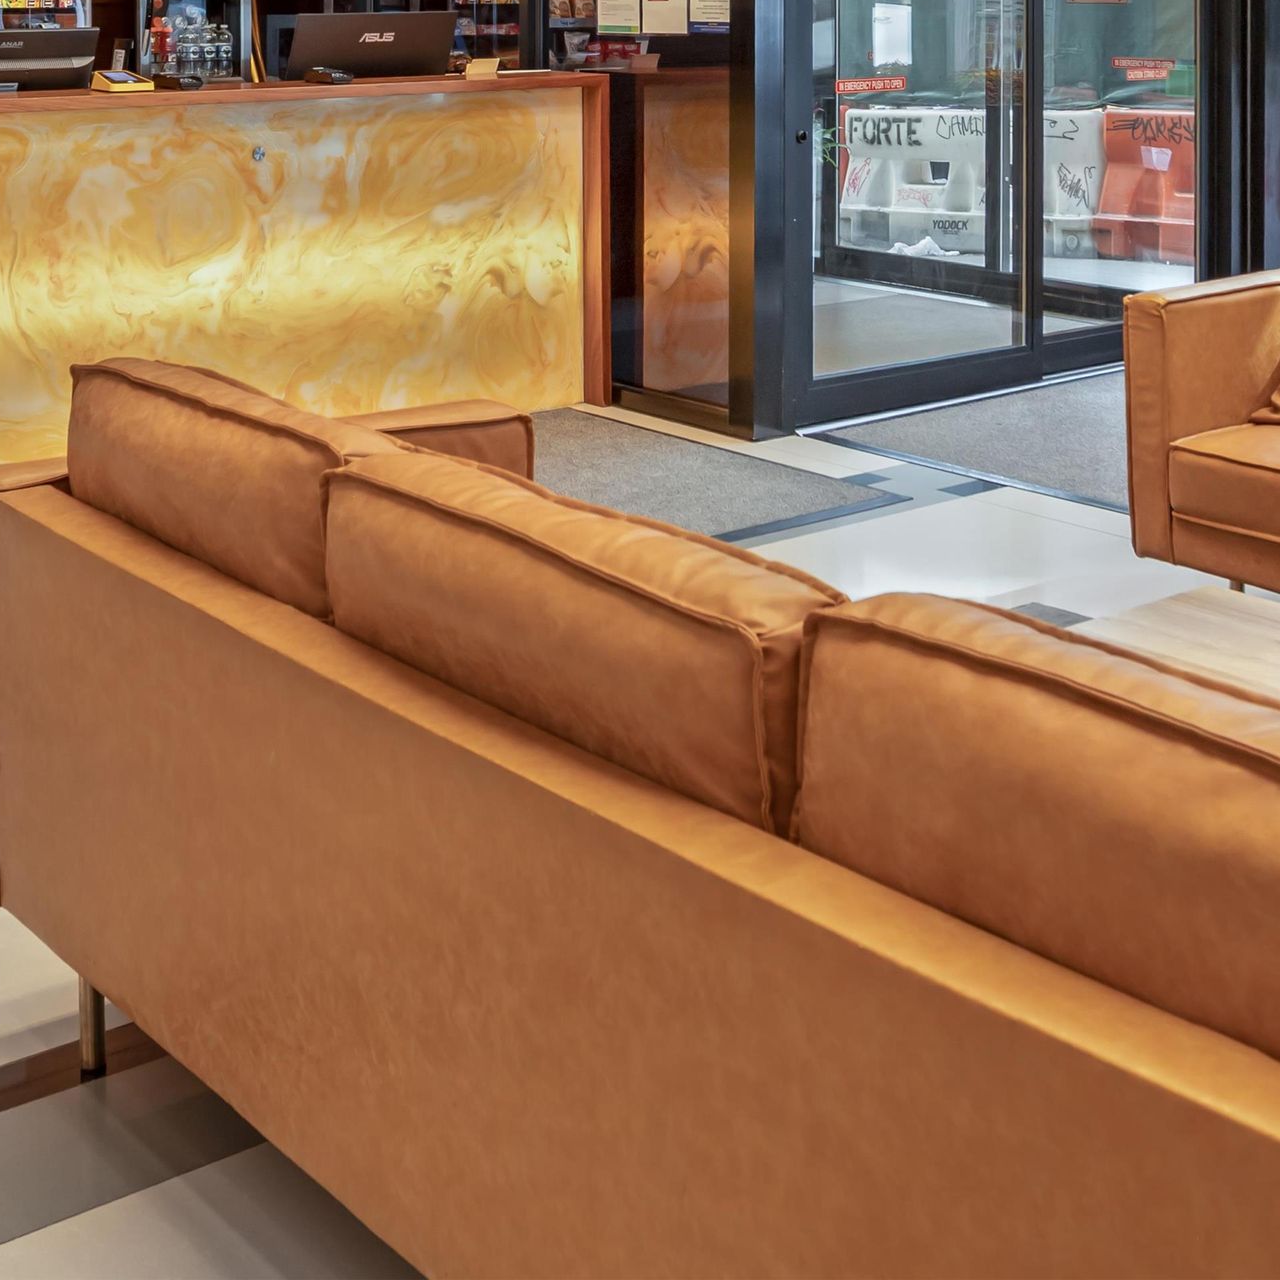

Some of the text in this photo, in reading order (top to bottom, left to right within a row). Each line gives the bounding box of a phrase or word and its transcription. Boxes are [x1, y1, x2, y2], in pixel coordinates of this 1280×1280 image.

[359, 32, 395, 43] ASUS
[844, 81, 871, 91] EMERGENCY
[872, 80, 884, 90] PUSH
[890, 79, 903, 89] OPEN
[849, 117, 923, 146] FORTE
[933, 220, 968, 231] YODOCK
